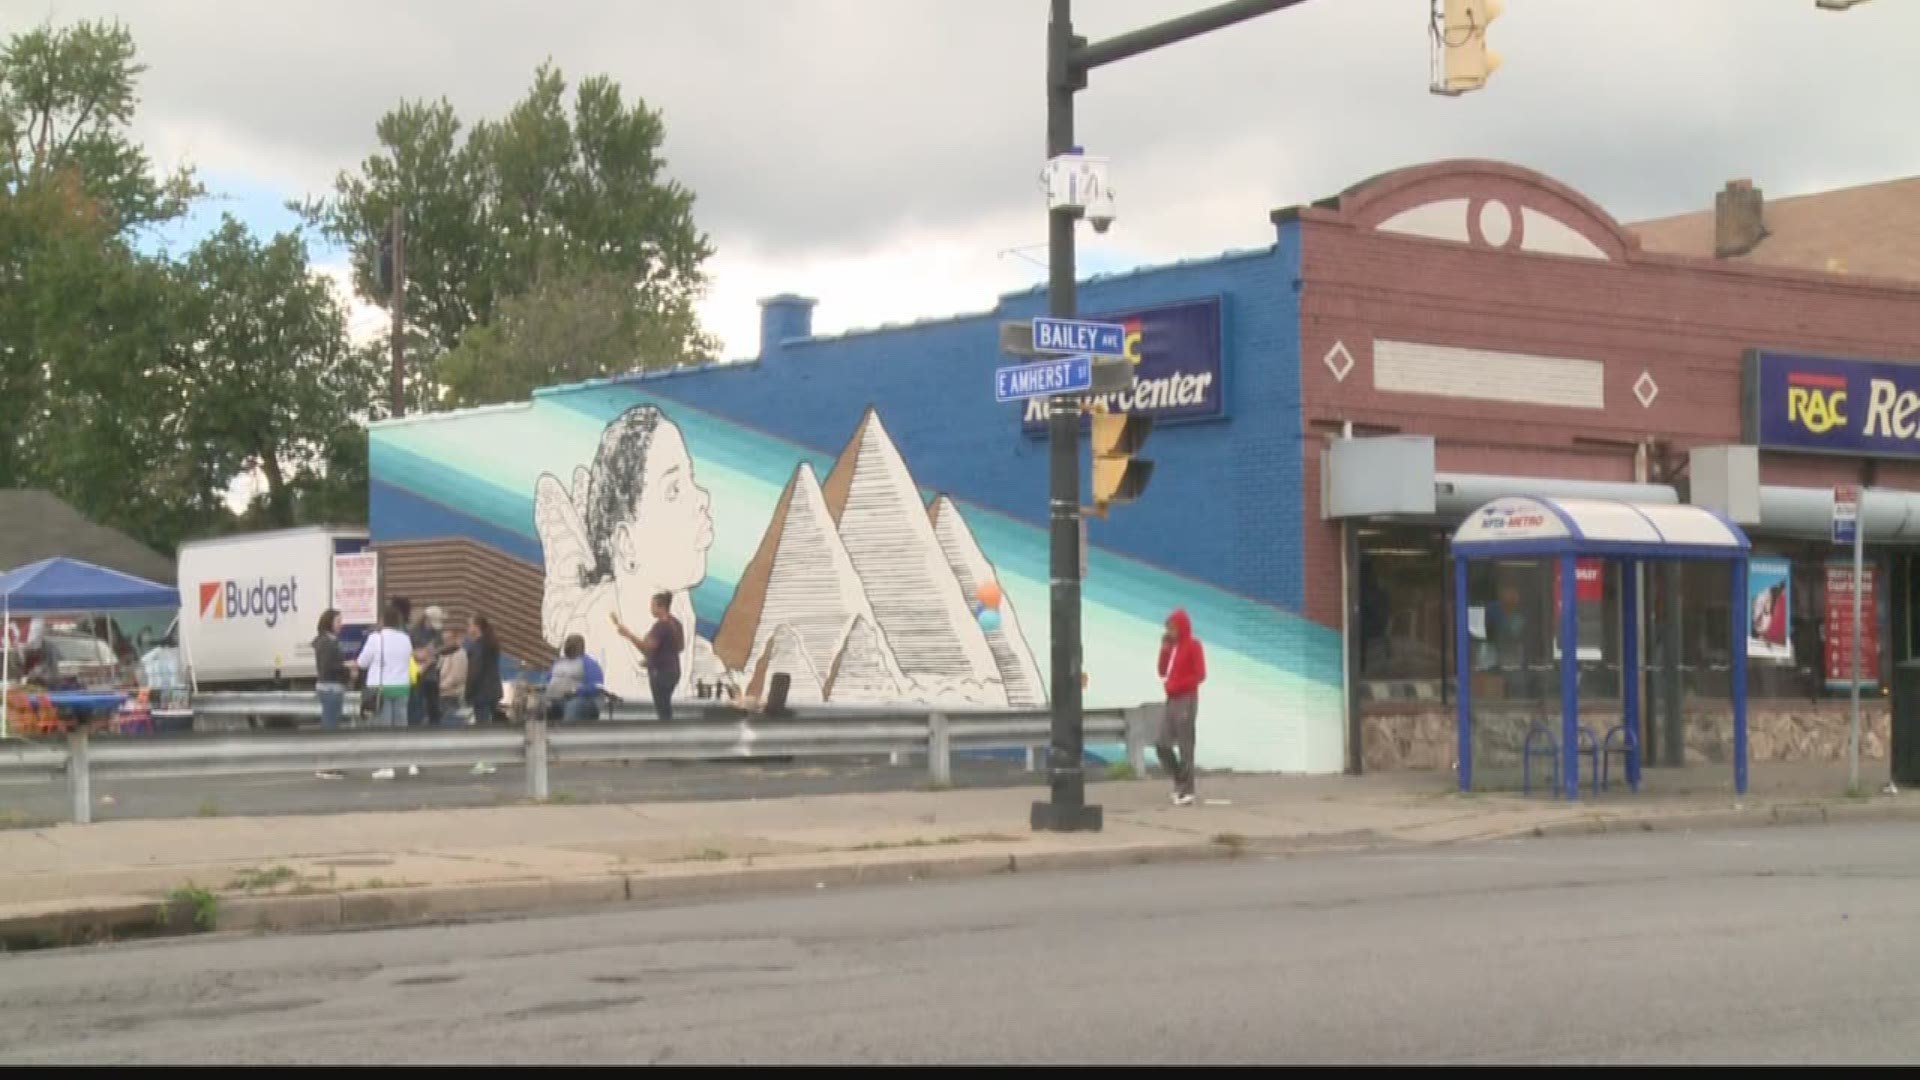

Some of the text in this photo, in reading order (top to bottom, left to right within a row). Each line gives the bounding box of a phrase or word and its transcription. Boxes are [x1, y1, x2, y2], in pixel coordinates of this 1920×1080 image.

[1040, 323, 1118, 349] BAILEY AVE
[999, 371, 1007, 396] E
[1010, 363, 1071, 392] AMHERST
[1787, 378, 1920, 439] RAC Re
[225, 575, 298, 628] Budget
